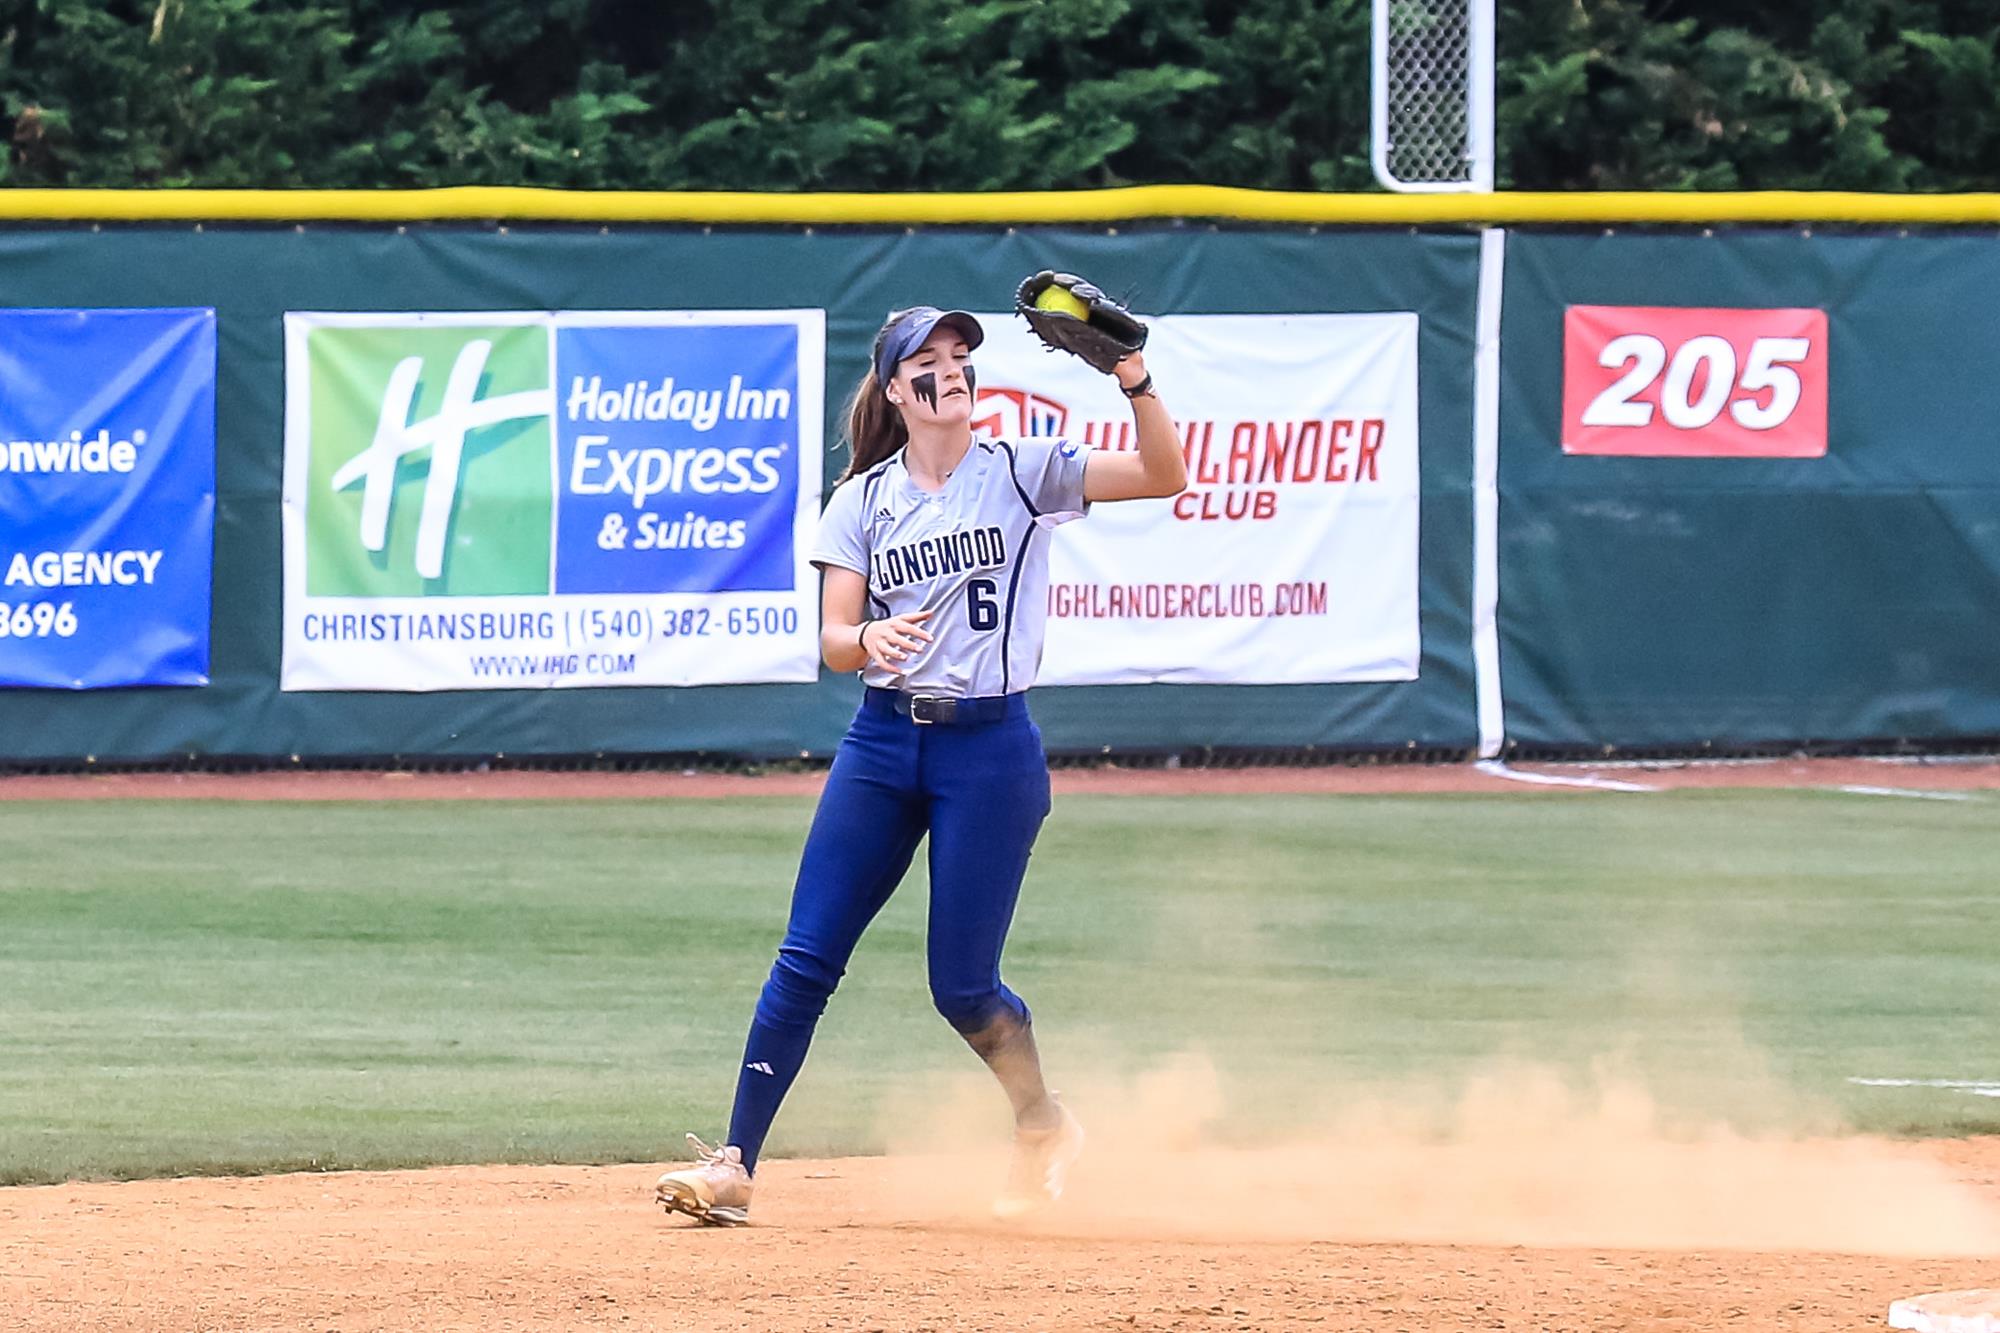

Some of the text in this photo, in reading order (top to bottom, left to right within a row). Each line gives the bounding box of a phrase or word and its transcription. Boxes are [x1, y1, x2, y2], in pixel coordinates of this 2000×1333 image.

[566, 374, 791, 431] Holiday Inn
[1580, 334, 1811, 430] 205
[570, 435, 781, 509] Express
[1084, 420, 1384, 483] LANDER
[1173, 490, 1278, 520] CLUB
[597, 511, 747, 550] & Suites
[4, 550, 163, 587] AGENCY
[874, 526, 1006, 592] LONGWOOD
[967, 578, 999, 632] 6
[1047, 582, 1328, 618] IGHLANDERCLUB.COM
[303, 612, 555, 642] CHRISTIANSBURG
[580, 607, 653, 644] (540)
[662, 607, 798, 638] 382-6500
[470, 653, 636, 677] WWWIHGCOM
